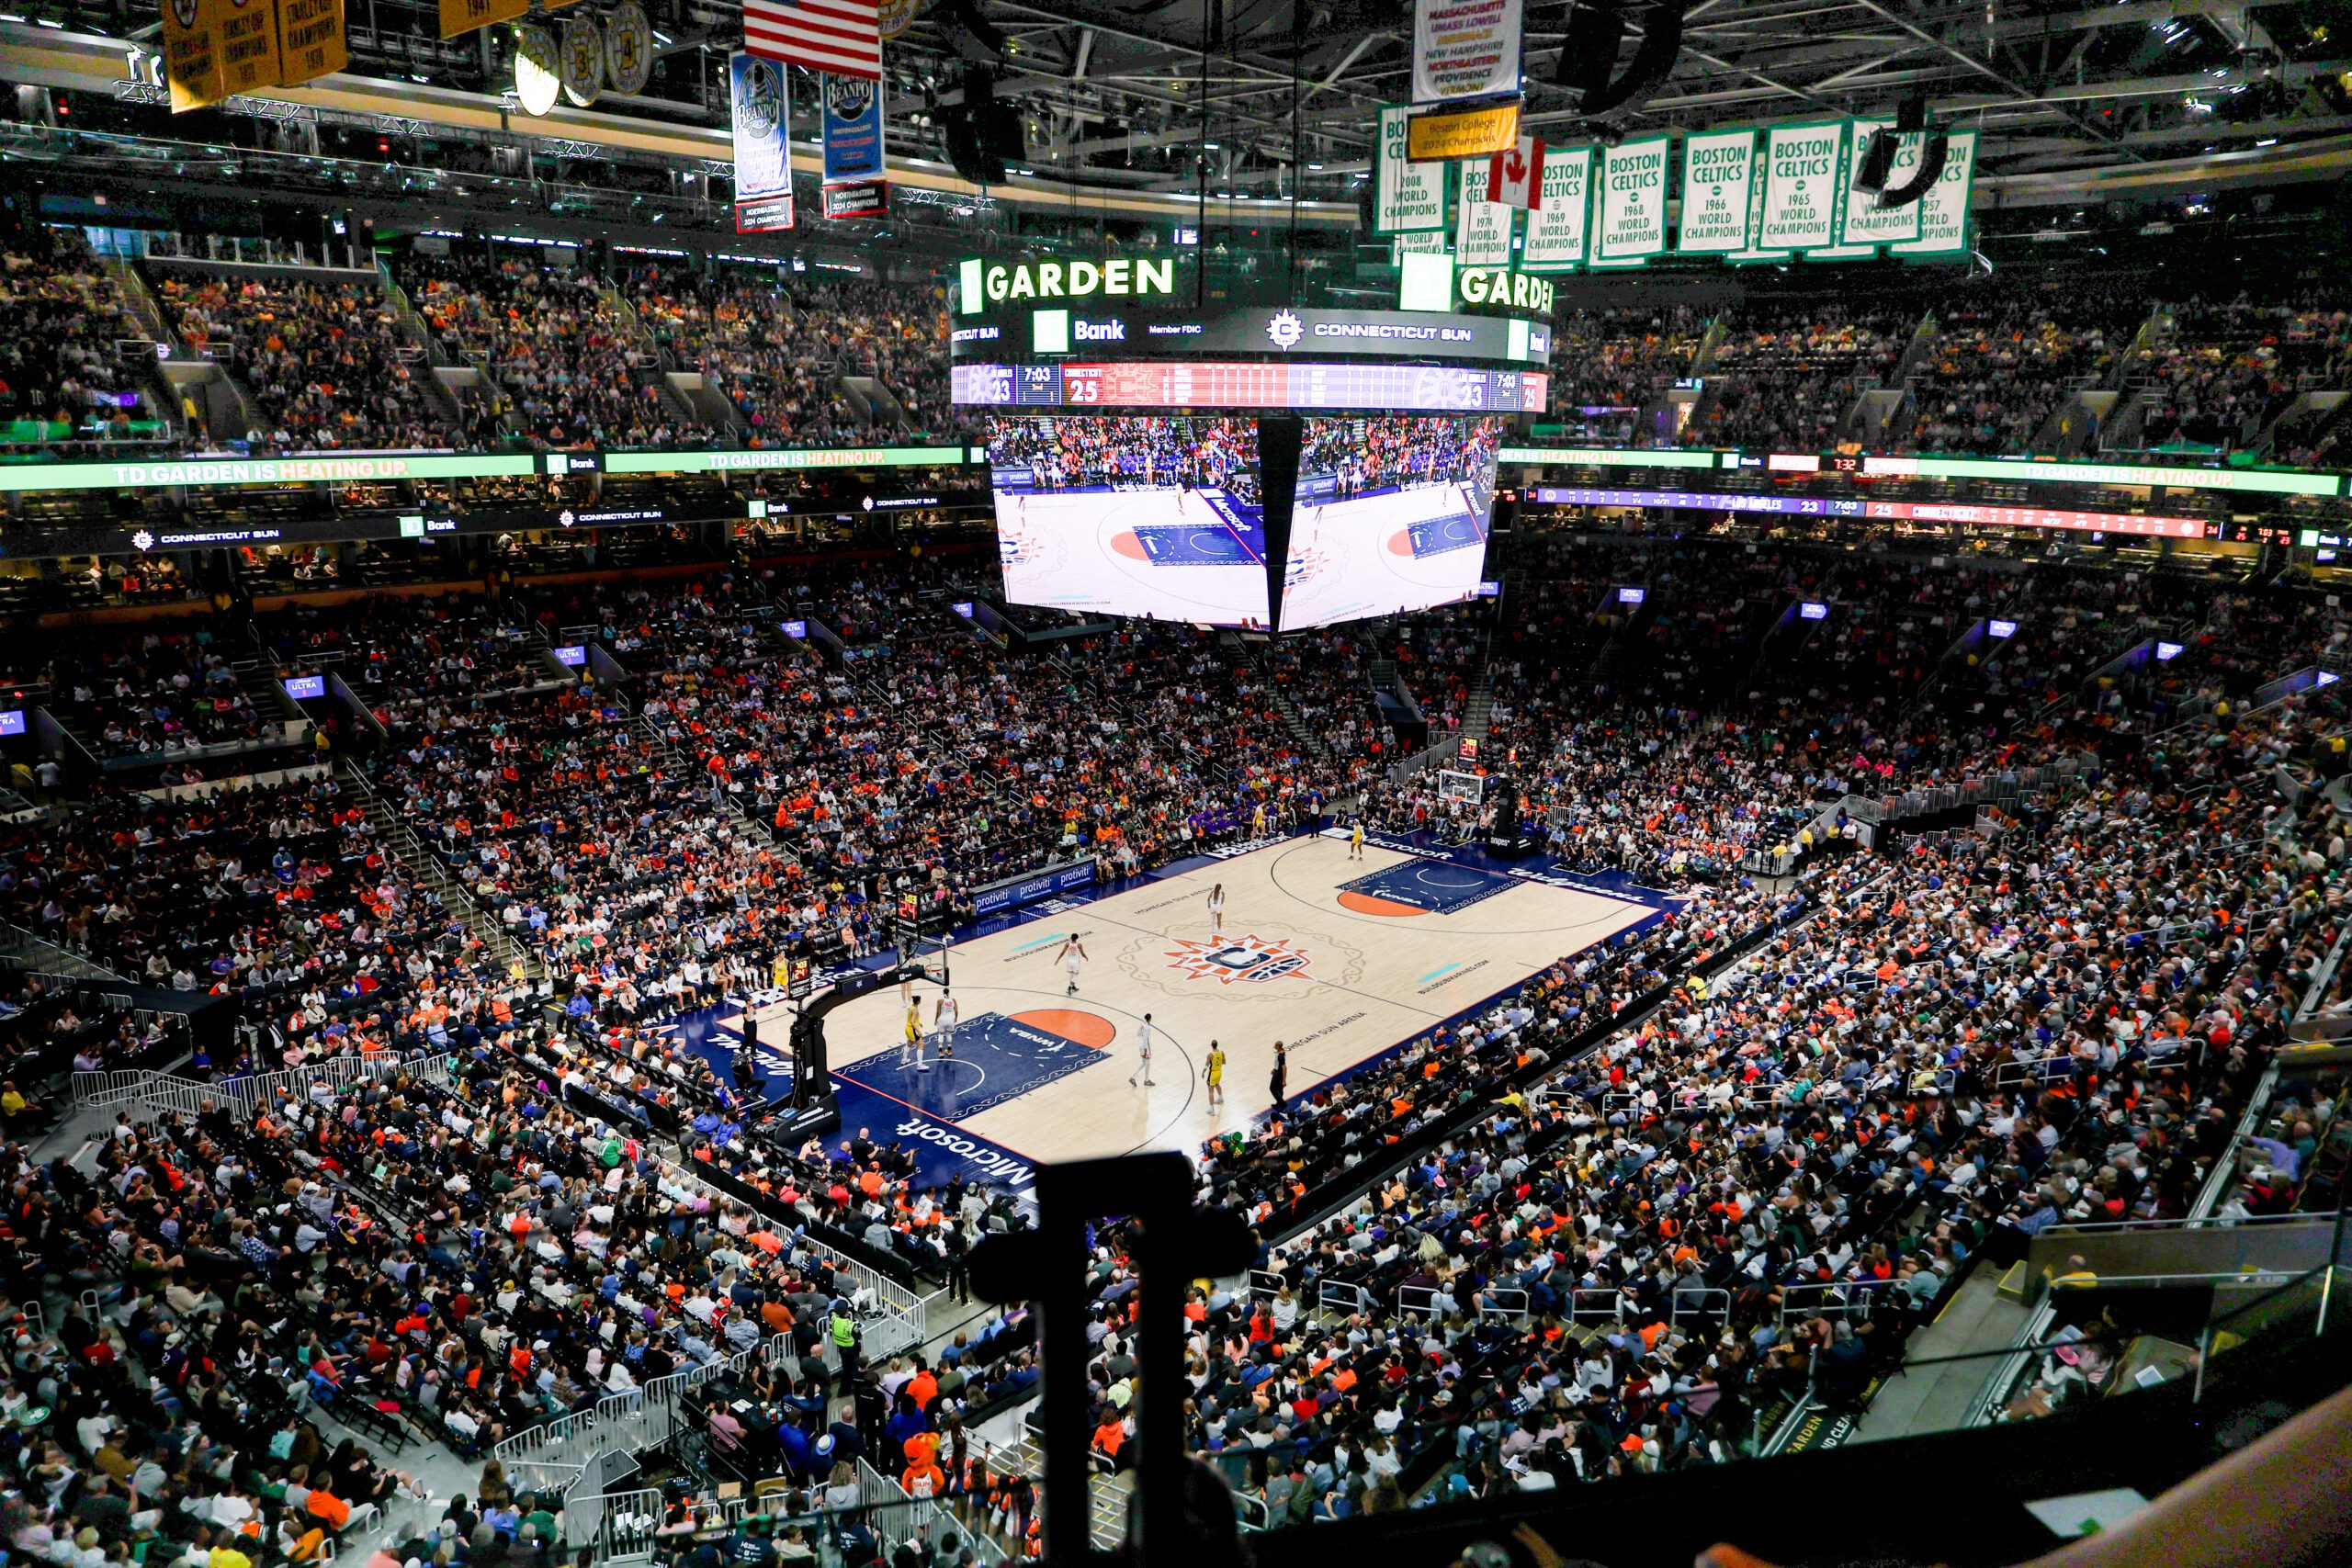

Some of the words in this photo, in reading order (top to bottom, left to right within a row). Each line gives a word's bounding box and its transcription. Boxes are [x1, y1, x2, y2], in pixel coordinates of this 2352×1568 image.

[1428, 0, 1506, 20] MASSACHUSETTS
[1430, 19, 1464, 33] UMASS
[1465, 14, 1501, 28] LOWELL
[1424, 48, 1449, 60] NEW
[1450, 39, 1505, 56] HAMPSHIRE
[1427, 54, 1501, 73] NORTHEASTERN
[1433, 68, 1492, 84] PROVIDENCE
[1441, 82, 1485, 96] VERMONT
[736, 98, 780, 129] BEANPOT
[1429, 121, 1461, 134] Boston
[1461, 117, 1496, 132] College
[1422, 139, 1446, 151] 2024
[1447, 133, 1496, 148] Champions
[1775, 139, 1834, 159] BOSTON
[1610, 152, 1661, 175] BOSTON
[1692, 146, 1747, 166] BOSTON
[1543, 164, 1584, 181] OSTON
[1692, 164, 1743, 184] CELTICS
[1776, 158, 1829, 178] CELTICS
[1400, 175, 1422, 188] 2008
[1541, 180, 1580, 198] ELTICS
[1611, 171, 1659, 191] CELTICS
[834, 187, 876, 199] NORTHEASTERN
[1396, 189, 1429, 203] WORLD
[1788, 194, 1810, 206] 1965
[745, 204, 782, 217] NORTHEASTERN
[846, 197, 879, 209] CHAMPIONS
[1385, 203, 1438, 219] CHAMPIONS
[1623, 205, 1645, 216] 1968
[1705, 199, 1726, 210] 1966
[756, 214, 786, 226] CHAMPIONS
[1546, 212, 1566, 224] 1969
[1699, 212, 1732, 225] WORLD
[1780, 208, 1816, 220] WORLD
[1850, 213, 1914, 230] CHAMPIONS
[1476, 217, 1494, 229] 1974
[1540, 225, 1571, 237] WORLD
[1618, 218, 1650, 231] WORLD
[1767, 220, 1826, 236] CHAMPIONS
[1406, 233, 1434, 245] WORLD
[1470, 230, 1498, 243] WORLD
[1607, 230, 1659, 245] CHAMPIONS
[1685, 225, 1742, 240] CHAMPIONS
[1459, 243, 1507, 254] CHAMPIONS
[1529, 237, 1580, 250] CHAMPIONS
[987, 259, 1173, 301] GARDEN
[1459, 266, 1555, 315] GARDEN
[978, 327, 999, 339] SUN
[1075, 319, 1126, 340] Bank
[1148, 325, 1182, 335] Member
[1182, 324, 1202, 334] FDIC
[1313, 322, 1439, 341] CONNECTICUT
[1440, 327, 1472, 342] SUN
[1024, 367, 1051, 382] 7:03
[1497, 374, 1516, 389] 7:03
[992, 379, 1011, 402] 23
[1031, 382, 1044, 391] 2nd
[1069, 379, 1099, 402] 25
[1461, 384, 1483, 408] 23
[1524, 387, 1536, 409] 25
[570, 457, 595, 470] Bank
[708, 454, 729, 468] TD
[729, 453, 788, 468] GARDEN
[790, 452, 805, 466] IS
[806, 450, 865, 467] HEATING
[865, 450, 886, 464] UP.
[1530, 450, 1540, 462] IS
[1541, 449, 1600, 463] HEATING
[1602, 451, 1623, 464] UP.
[1740, 457, 1762, 467] Bank
[1834, 458, 1857, 470] 7:32
[112, 465, 148, 485] TD
[150, 462, 252, 483] GARDEN
[254, 462, 277, 481] IS
[279, 460, 375, 481] HEATING
[377, 459, 410, 478] UP.
[2023, 464, 2044, 479] TD
[2046, 466, 2112, 482] GARDEN
[2113, 468, 2130, 482] IS
[2132, 468, 2209, 486] HEATING
[2211, 471, 2234, 487] UP.
[1312, 480, 1334, 492] protiviti
[750, 503, 764, 515] TD
[766, 502, 788, 514] Bank
[876, 498, 922, 506] CONNECTICUT
[922, 497, 938, 505] SUN
[1464, 489, 1486, 517] Microsoft
[1731, 497, 1747, 510] LOS
[1747, 498, 1782, 511] ANGELES
[1800, 501, 1818, 513] 23
[1834, 501, 1858, 511] 7:03
[579, 513, 640, 523] CONNECTICUT
[642, 511, 662, 520] SUN
[1211, 498, 1251, 533] Microsoft
[1874, 504, 1893, 516] 25
[401, 520, 422, 535] TD
[426, 519, 457, 532] Bank
[2154, 525, 2165, 533] 12
[2207, 525, 2218, 535] 24
[160, 530, 252, 544] CONNECTICUT
[253, 528, 280, 539] SUN
[2279, 536, 2291, 546] 23
[291, 682, 318, 691] ULTRA
[1461, 743, 1476, 757] 24
[1362, 834, 1453, 861] Microsoft
[1489, 835, 1508, 847] snipes
[1060, 865, 1090, 886] protiviti
[1020, 876, 1050, 898] protiviti
[1507, 867, 1645, 903] Walgreens
[976, 888, 1009, 911] protiviti
[1134, 900, 1171, 916] MOHEGAN
[1171, 895, 1191, 907] SUN
[1381, 891, 1422, 905] WNBA
[898, 900, 916, 920] 24
[794, 969, 806, 980] 24
[1418, 958, 1490, 995] BUILDSUBMARINES.COM
[1320, 1023, 1340, 1038] SUN
[1338, 1010, 1367, 1028] ARENA
[1010, 1026, 1056, 1048] WNBA
[602, 1141, 611, 1156] 7
[895, 1117, 1036, 1187] Microsoft
